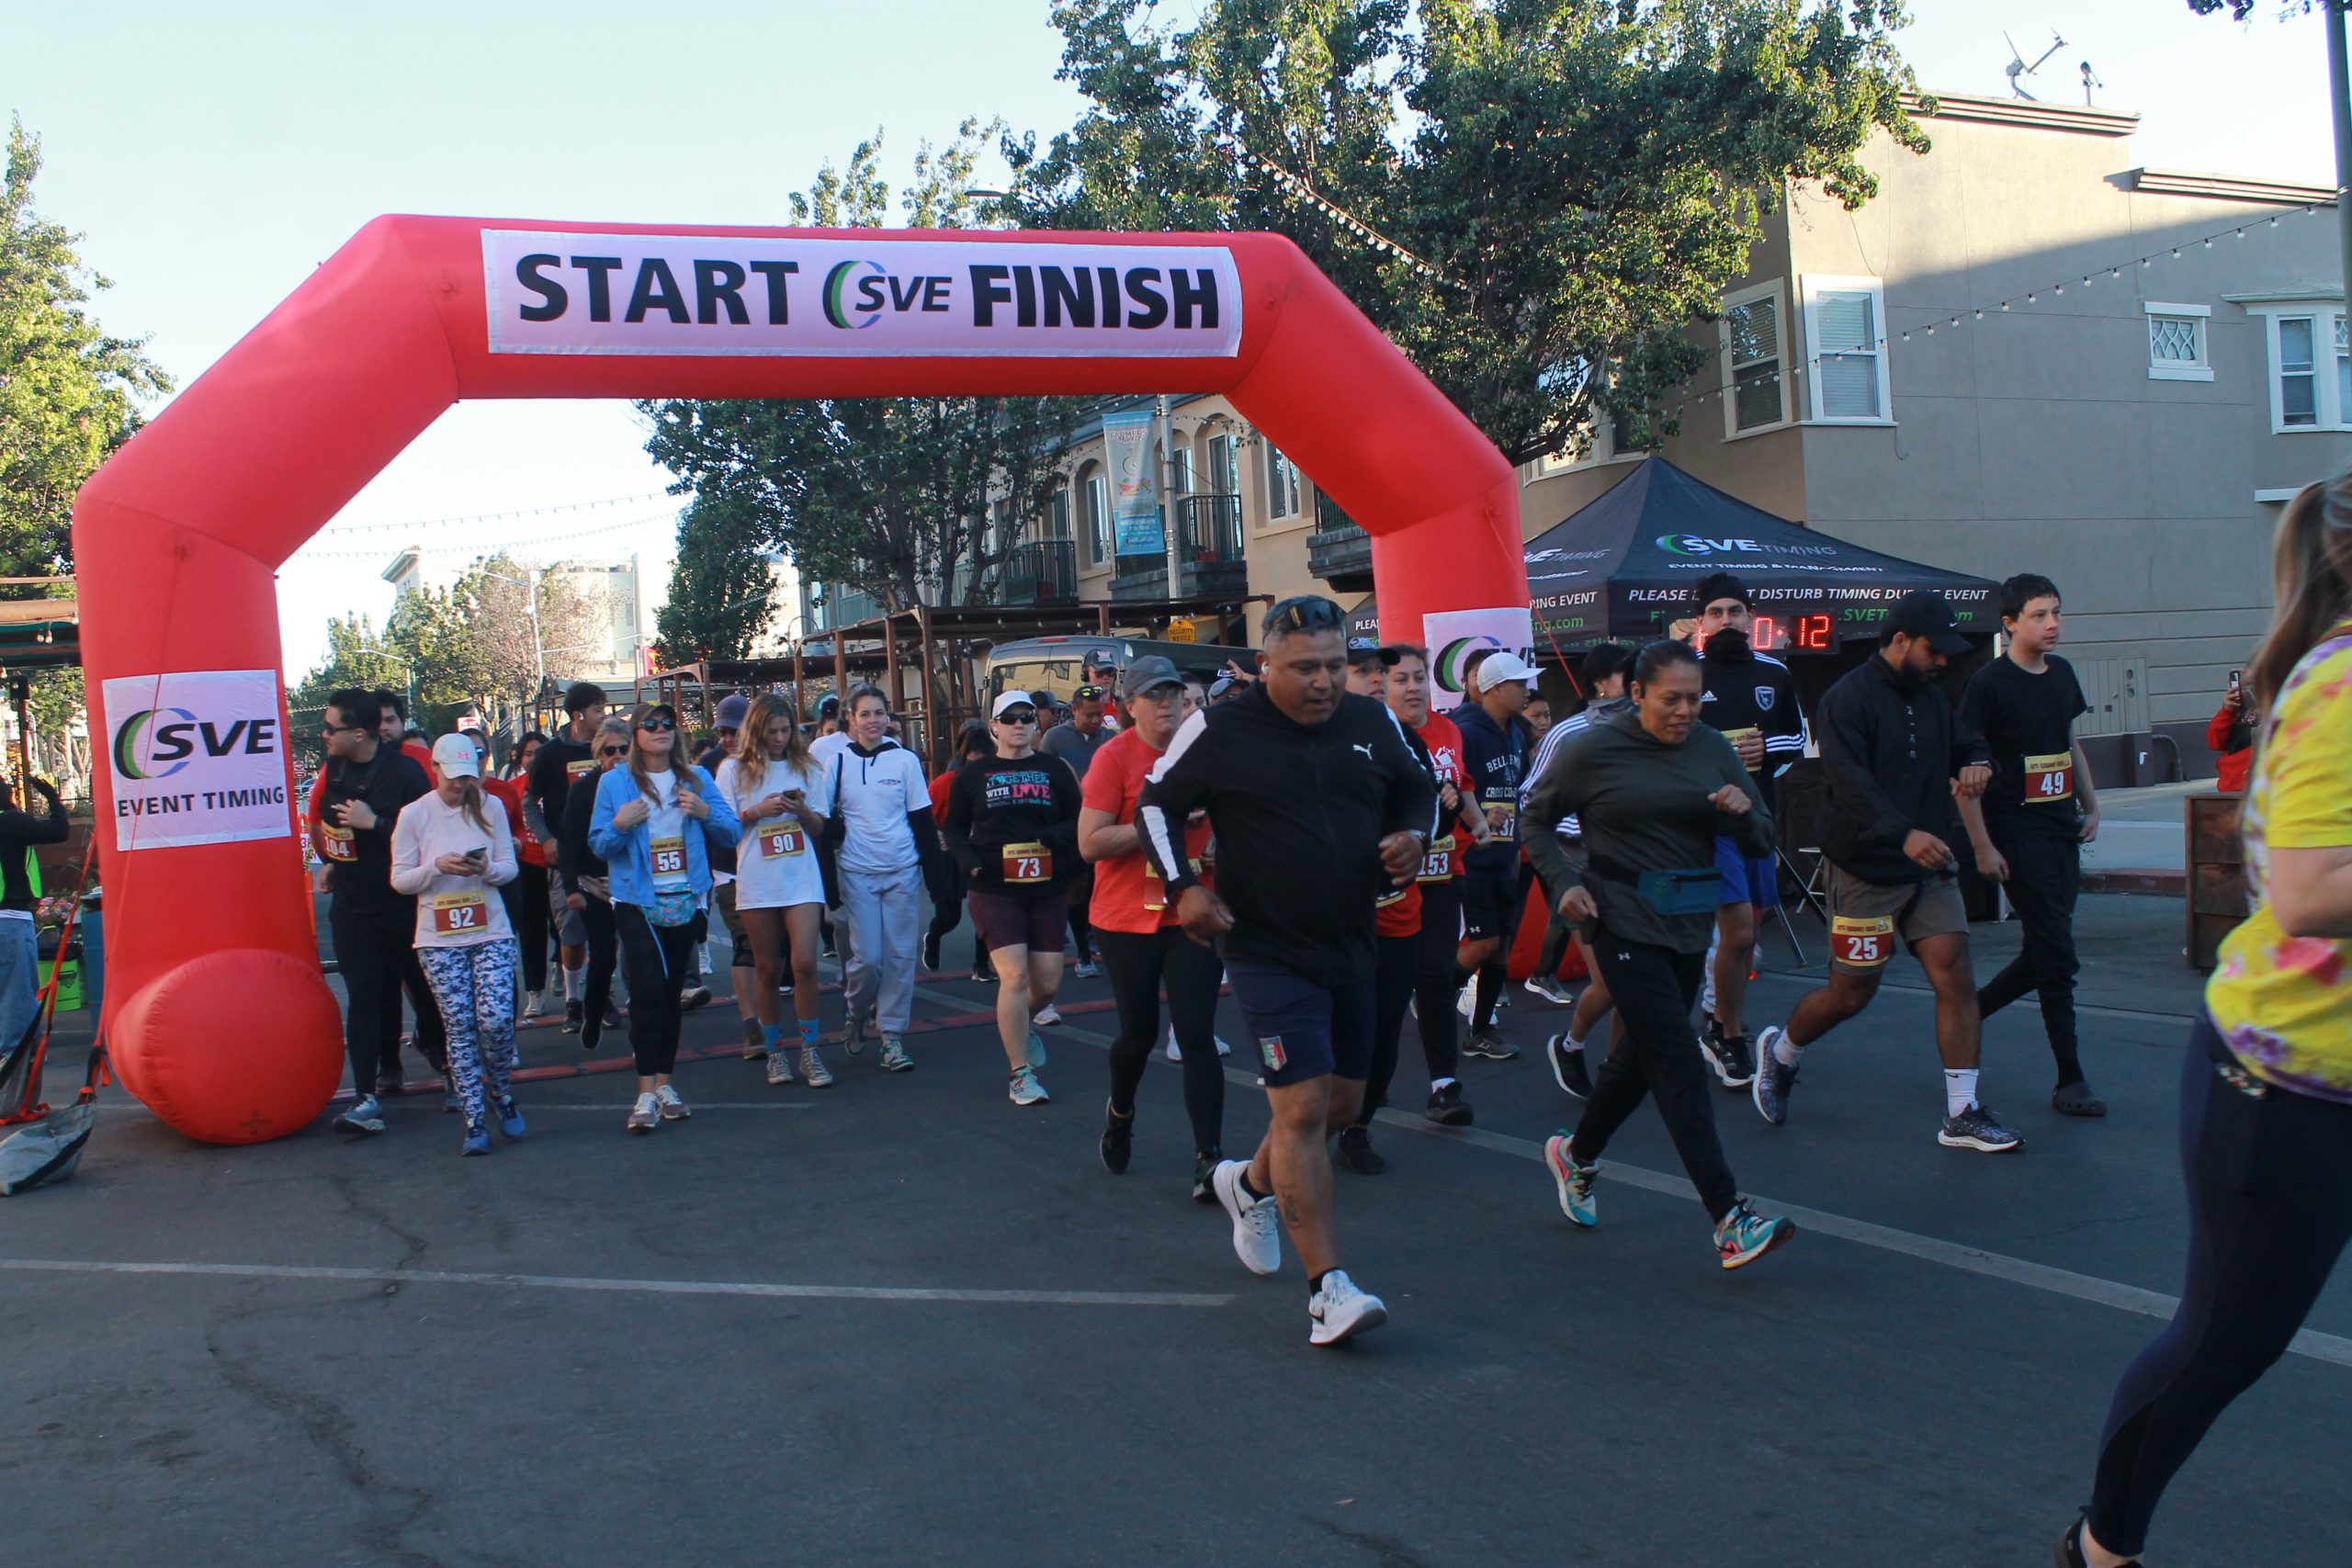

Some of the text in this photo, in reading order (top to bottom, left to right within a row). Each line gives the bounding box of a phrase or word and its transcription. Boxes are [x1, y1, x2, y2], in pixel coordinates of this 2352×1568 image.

[515, 254, 1219, 330] START SVE FINISH
[1559, 592, 1598, 606] EVENT
[1629, 589, 1688, 601] PLEASE
[1758, 589, 1823, 600] DISTURB
[1827, 589, 1881, 600] TIMING
[1944, 590, 1989, 600] EVENT
[152, 718, 276, 761] SVE
[986, 786, 1010, 798] WITH
[2041, 772, 2064, 795] 49
[118, 786, 284, 818] EVENT TIMING
[324, 835, 350, 857] 104
[773, 833, 795, 853] 90
[657, 851, 681, 872] 55
[1017, 857, 1041, 878] 73
[1417, 852, 1449, 875] 153
[449, 907, 475, 929] 92
[1848, 937, 1878, 960] 25
